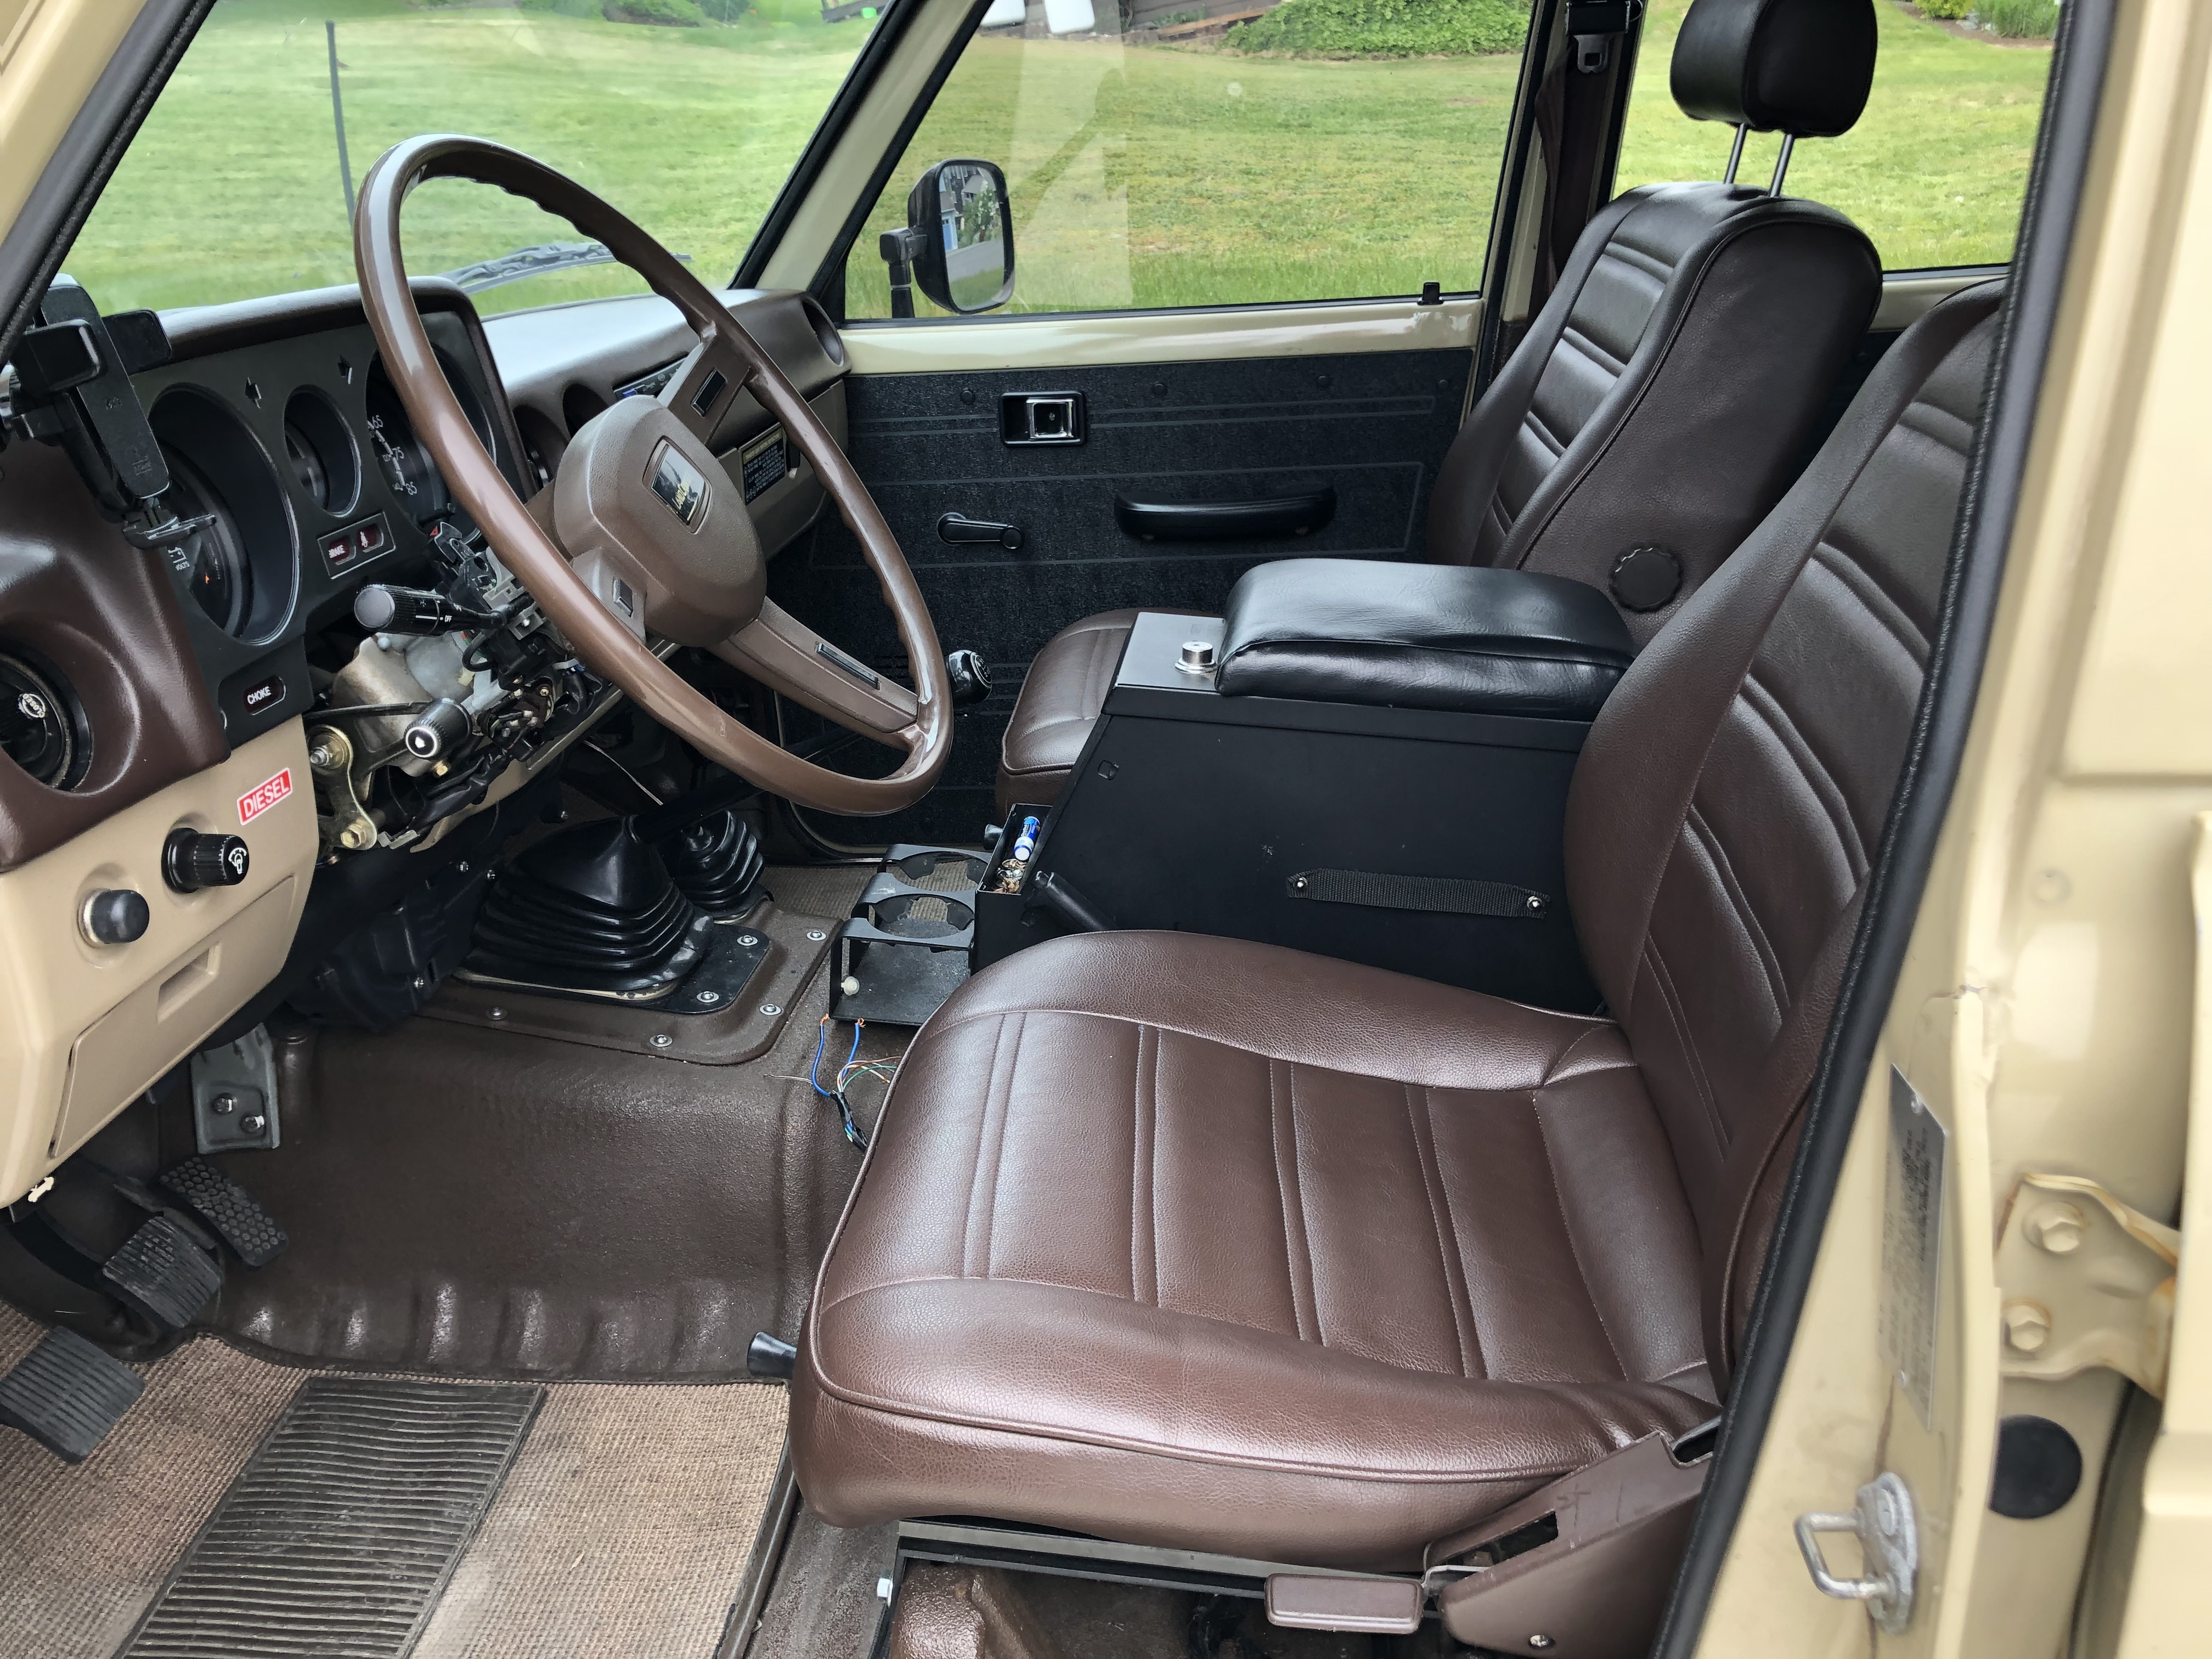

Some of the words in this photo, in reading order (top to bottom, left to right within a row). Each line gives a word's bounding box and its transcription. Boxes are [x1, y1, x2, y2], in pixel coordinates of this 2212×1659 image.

[372, 415, 383, 429] 65
[392, 446, 405, 460] 75
[405, 481, 417, 496] 85
[328, 544, 346, 558] BRAKE
[176, 561, 190, 571] VOLTS
[444, 614, 453, 623] OFF
[247, 686, 272, 704] CHOKE
[22, 693, 45, 718] CLOSED
[243, 776, 290, 818] DIESEL
